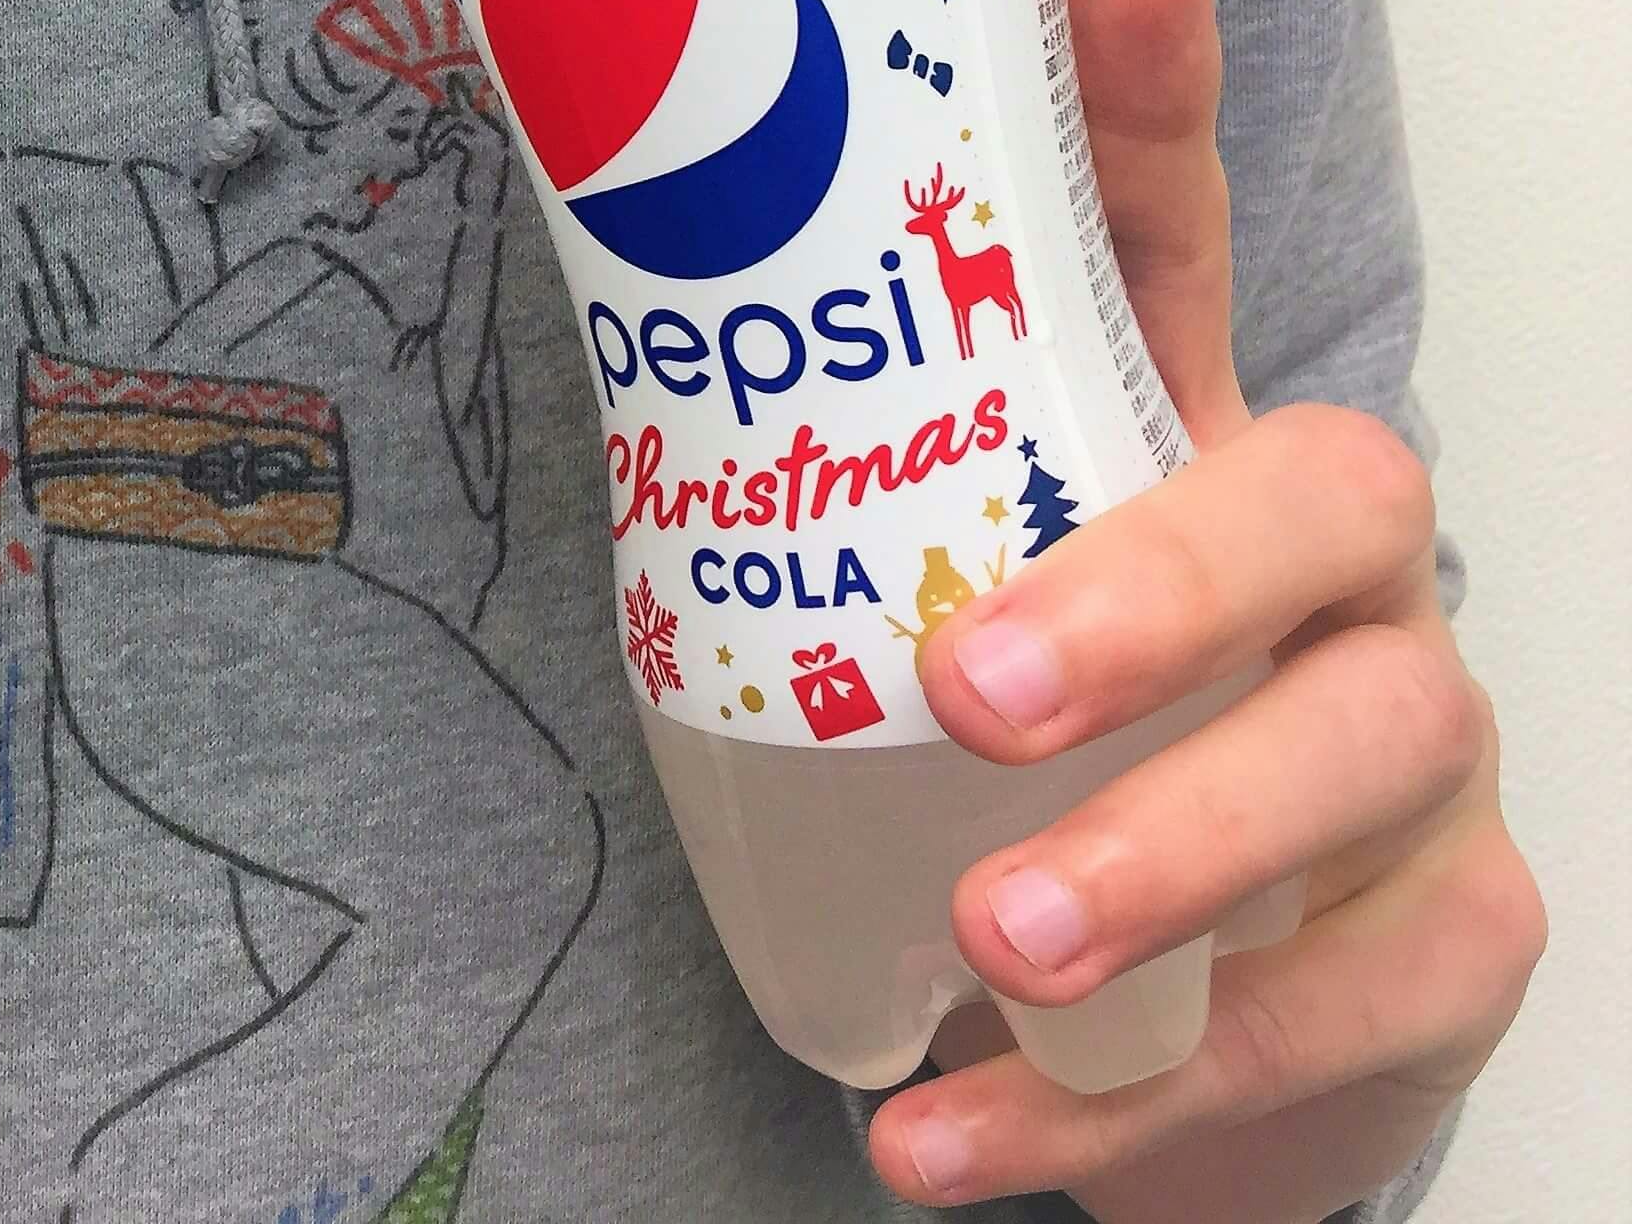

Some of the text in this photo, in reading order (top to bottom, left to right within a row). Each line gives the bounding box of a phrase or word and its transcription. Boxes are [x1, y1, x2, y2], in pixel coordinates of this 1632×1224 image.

[587, 249, 926, 426] pepsi
[605, 388, 1010, 542] Christmas
[689, 547, 883, 610] COLA
